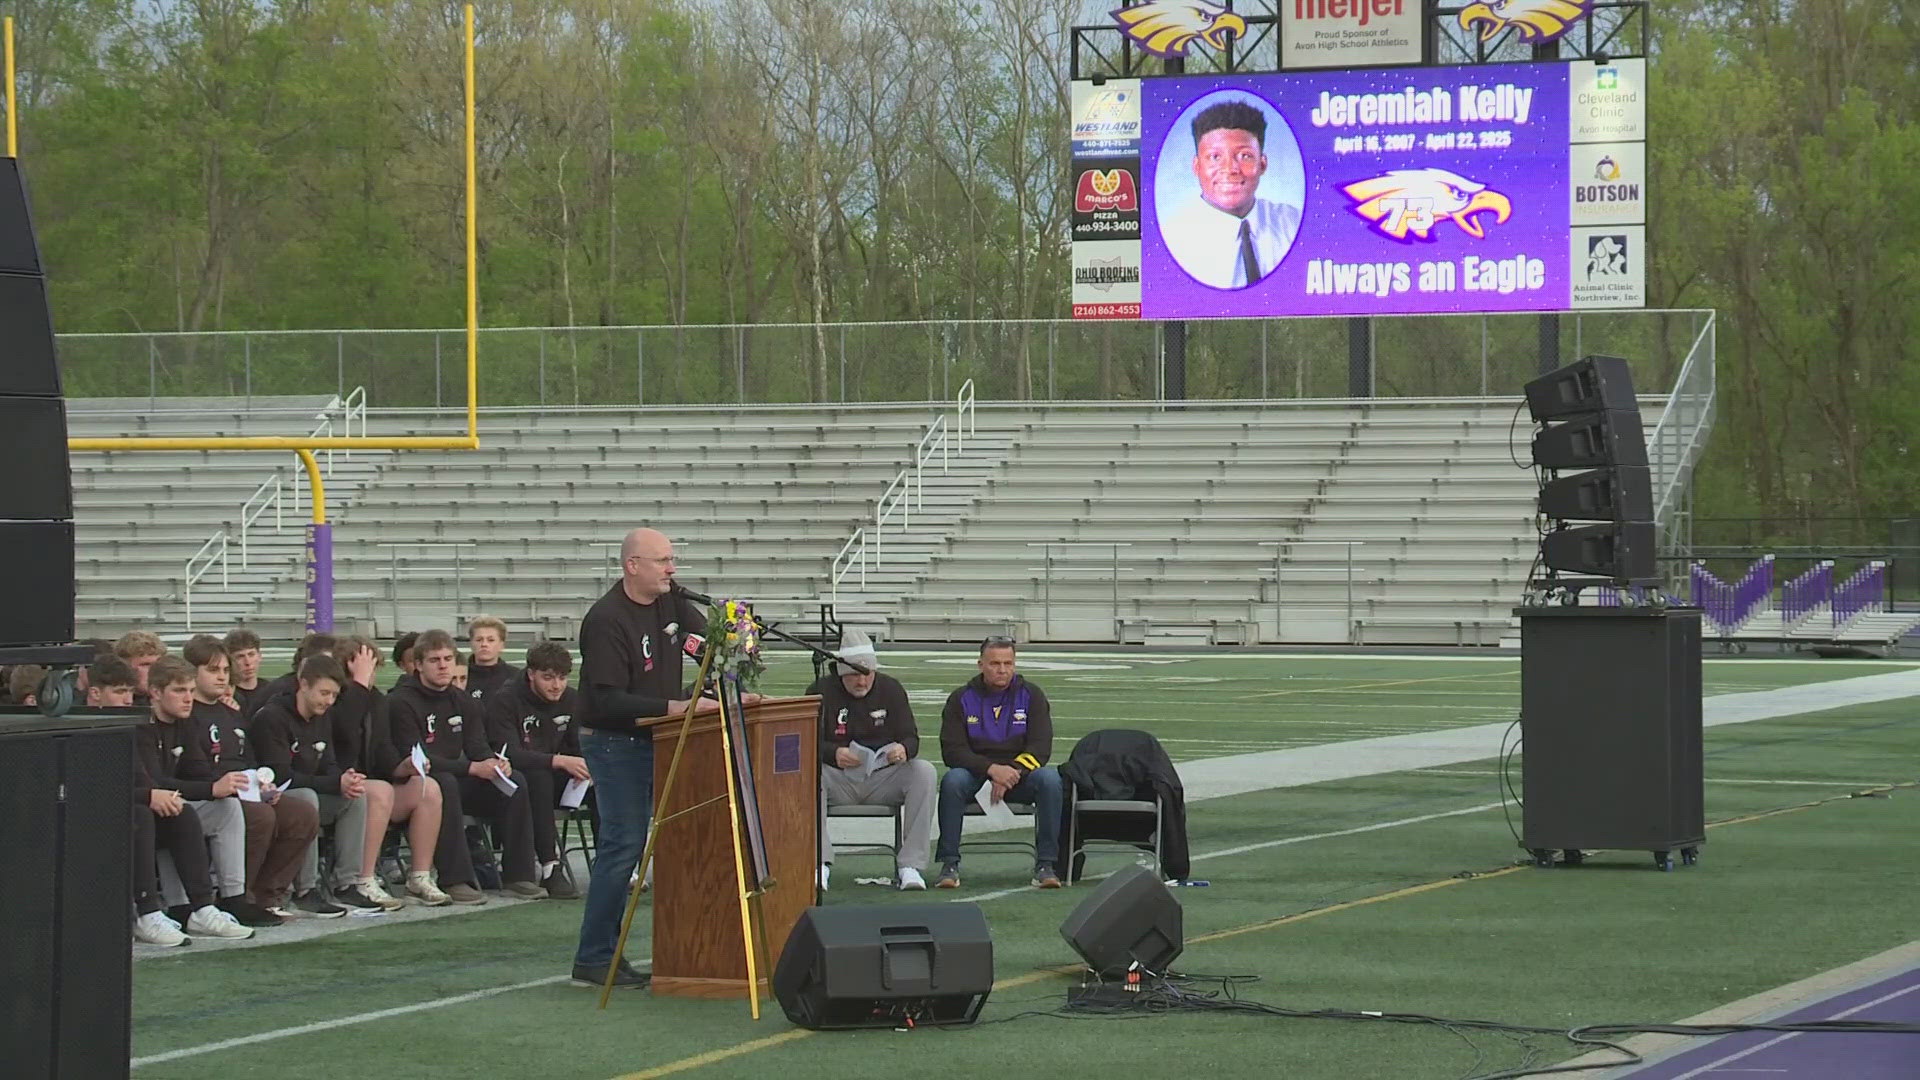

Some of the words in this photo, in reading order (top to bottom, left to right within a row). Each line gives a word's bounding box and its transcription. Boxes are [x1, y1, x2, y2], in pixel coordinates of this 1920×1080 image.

[1314, 30, 1340, 39] Proud
[1342, 30, 1377, 41] Sponsor
[1379, 28, 1389, 36] of
[1295, 42, 1316, 50] Avon
[1318, 41, 1338, 51] High
[1340, 38, 1369, 48] School
[1371, 38, 1409, 47] Athletics
[1578, 92, 1637, 104] Cleveland
[1311, 87, 1452, 126] Jeremiah
[1459, 84, 1533, 124] Kelly
[1590, 107, 1624, 118] Clinic
[1075, 122, 1138, 132] WESTLAND
[1334, 135, 1363, 155] April
[1384, 133, 1416, 152] 2007
[1426, 132, 1455, 152] April
[1457, 131, 1477, 150] 22,
[1479, 130, 1512, 148] 2025
[1576, 184, 1639, 202] BOTSON
[1379, 198, 1434, 231] 73
[1076, 221, 1138, 232] 440-934-3400
[1075, 267, 1098, 278] OHIO
[1100, 266, 1139, 277] ROOFING
[1306, 259, 1411, 297] Always
[1418, 261, 1456, 292] an
[1464, 254, 1546, 294] Eagle
[1074, 306, 1097, 316] (216)
[1099, 304, 1140, 315] 862-4553
